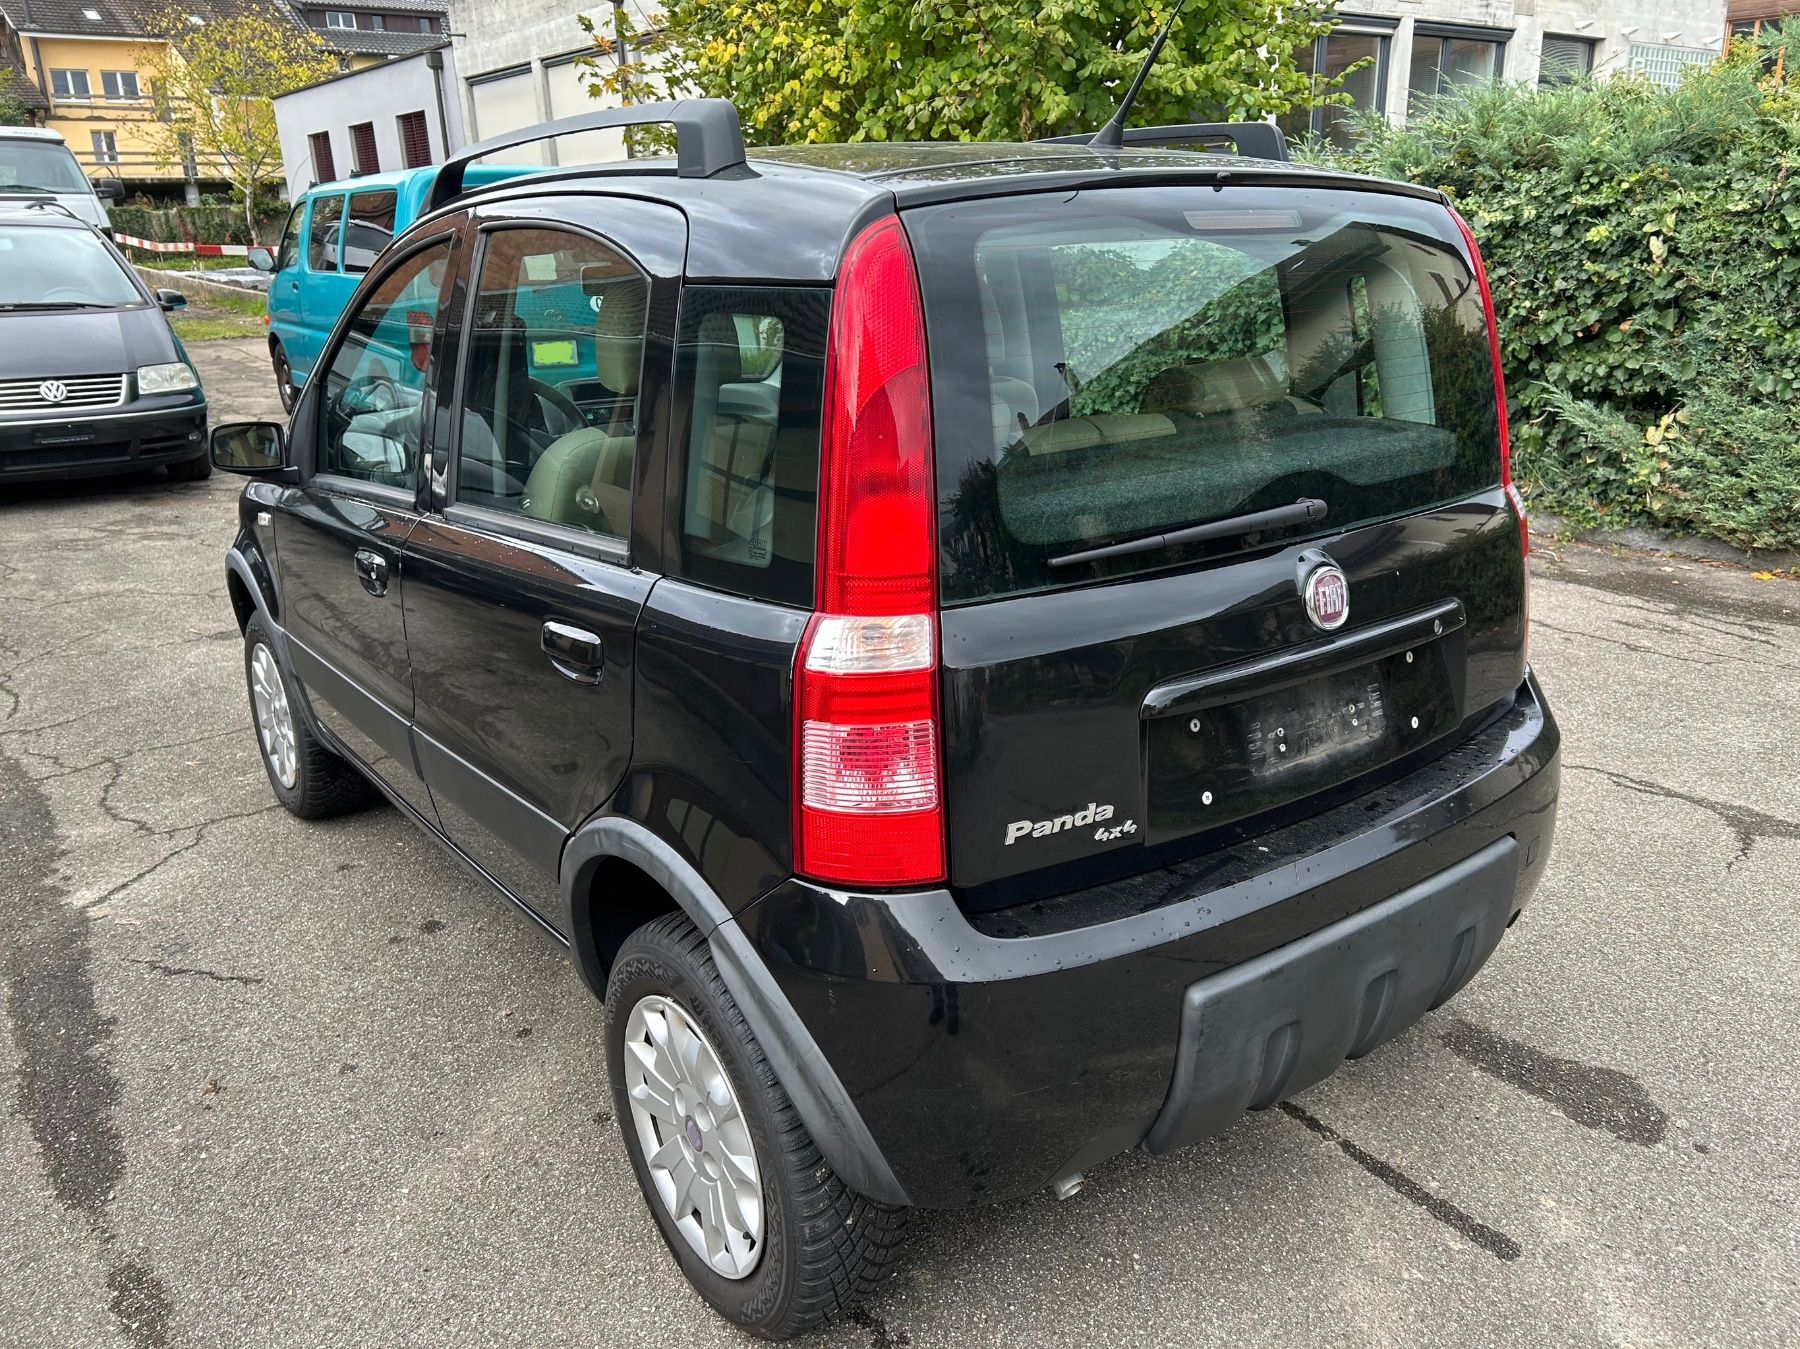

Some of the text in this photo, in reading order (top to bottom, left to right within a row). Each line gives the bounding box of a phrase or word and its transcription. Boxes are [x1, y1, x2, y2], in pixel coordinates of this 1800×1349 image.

[41, 380, 66, 401] VW
[1317, 582, 1343, 615] FIAT
[1004, 802, 1115, 846] Panda
[1093, 819, 1138, 842] 4x4
